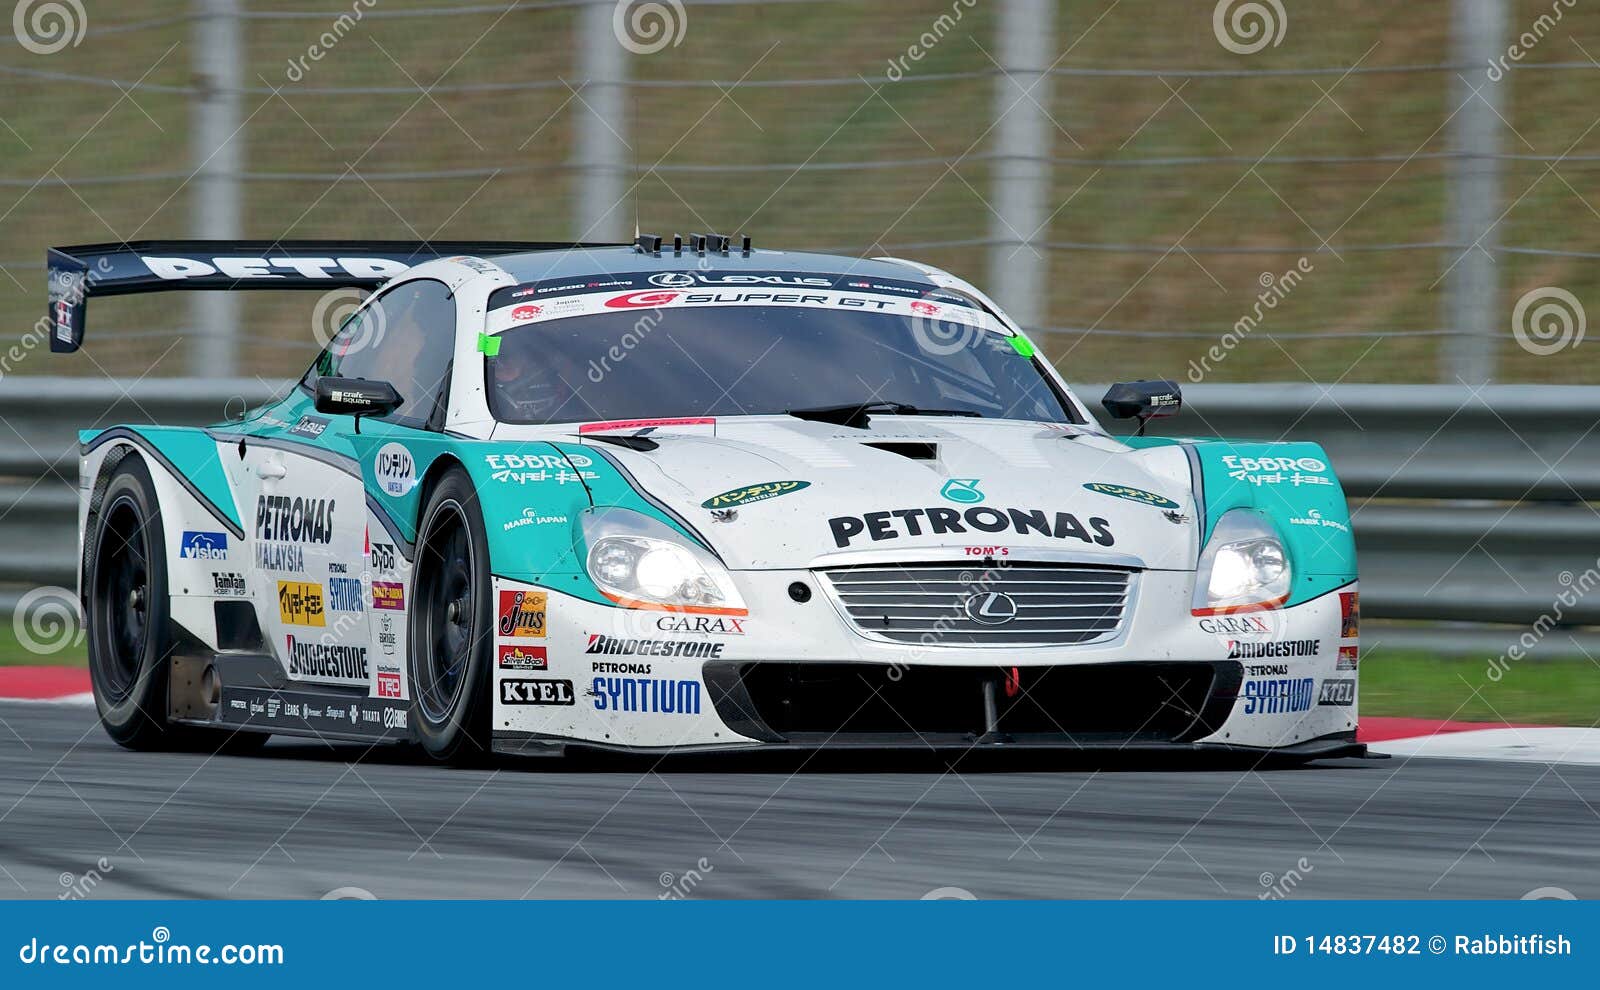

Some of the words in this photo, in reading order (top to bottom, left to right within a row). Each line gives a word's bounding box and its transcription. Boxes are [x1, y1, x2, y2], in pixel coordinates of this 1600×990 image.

[699, 273, 833, 287] LEXUS
[684, 293, 832, 304] SUPER
[838, 297, 896, 309] GT
[343, 397, 371, 405] square
[379, 453, 412, 478] バンテリン
[485, 454, 593, 469] EBBRO
[1222, 455, 1326, 473] EBBRO
[713, 481, 798, 506] バンテリン
[256, 495, 336, 544] PETRONAS
[503, 517, 534, 530] MARK
[537, 516, 567, 524] JAPAN
[828, 506, 1116, 548] PETRONAS
[1290, 517, 1320, 526] MARK
[1322, 519, 1349, 532] JAPAN
[184, 542, 227, 560] vision
[256, 542, 304, 572] MALAYSIA
[964, 546, 1009, 556] TOM'S
[372, 549, 395, 574] DyDo
[212, 572, 246, 589] TamTam
[329, 578, 364, 612] SYNTIUM
[656, 616, 750, 633] GARAX
[1199, 617, 1269, 633] GARAX
[586, 634, 725, 658] BRIDGESTONE
[1227, 639, 1320, 659] BRIDGESTONE
[286, 634, 369, 680] BRIDGESTONE
[592, 662, 652, 674] PETRONAS
[503, 682, 572, 702] KTEL
[593, 677, 701, 714] SYNTIUM
[1245, 678, 1314, 714] SYNTIUM
[1320, 682, 1353, 702] KTEL
[362, 709, 381, 722] TAKATA
